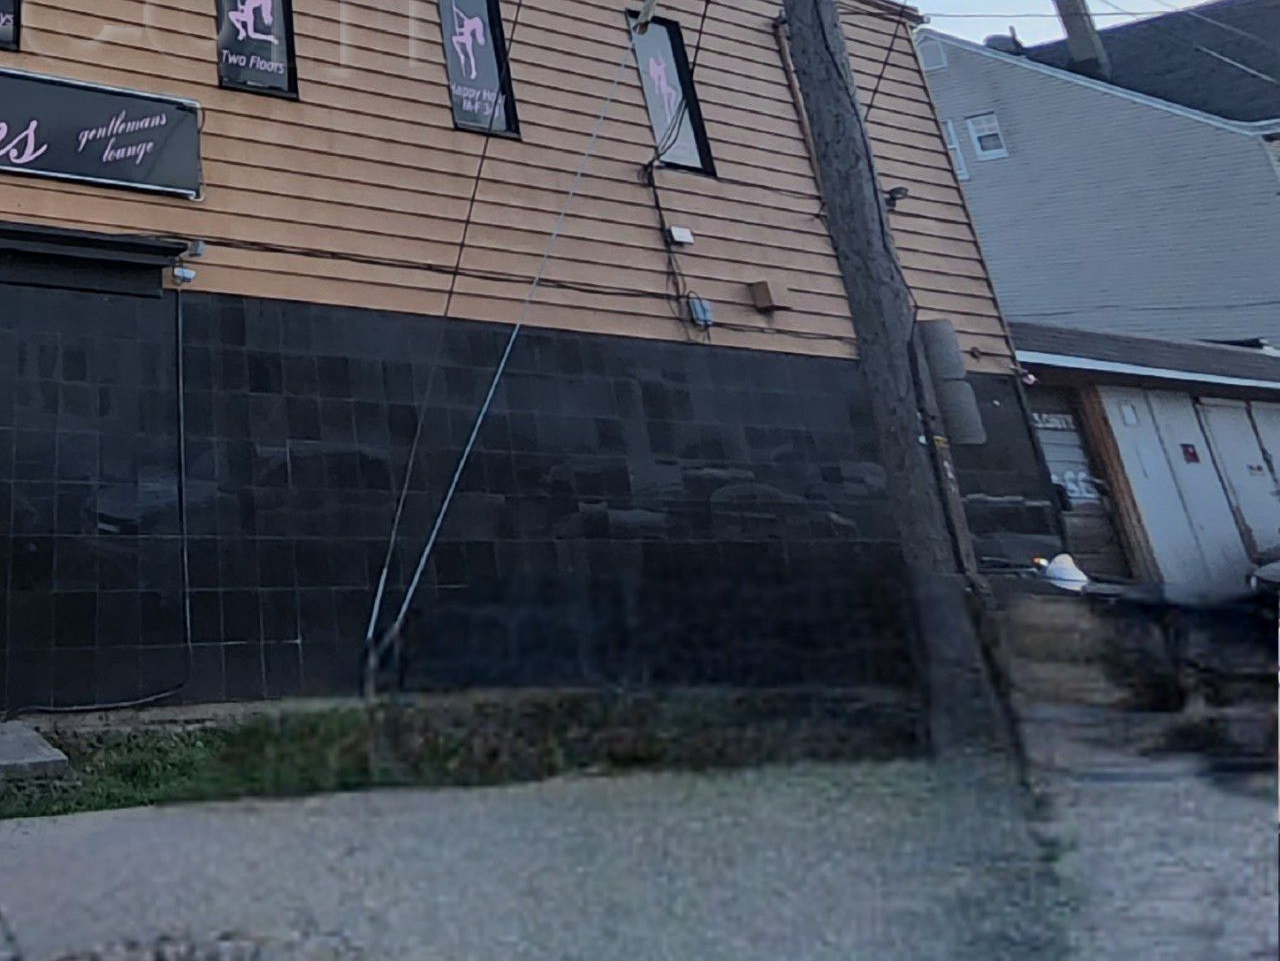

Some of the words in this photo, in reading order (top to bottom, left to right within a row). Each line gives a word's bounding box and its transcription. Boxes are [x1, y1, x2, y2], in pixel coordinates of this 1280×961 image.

[222, 49, 247, 67] Two
[249, 55, 284, 74] Floors
[78, 109, 167, 152] gentlemans
[102, 137, 154, 165] lounge
